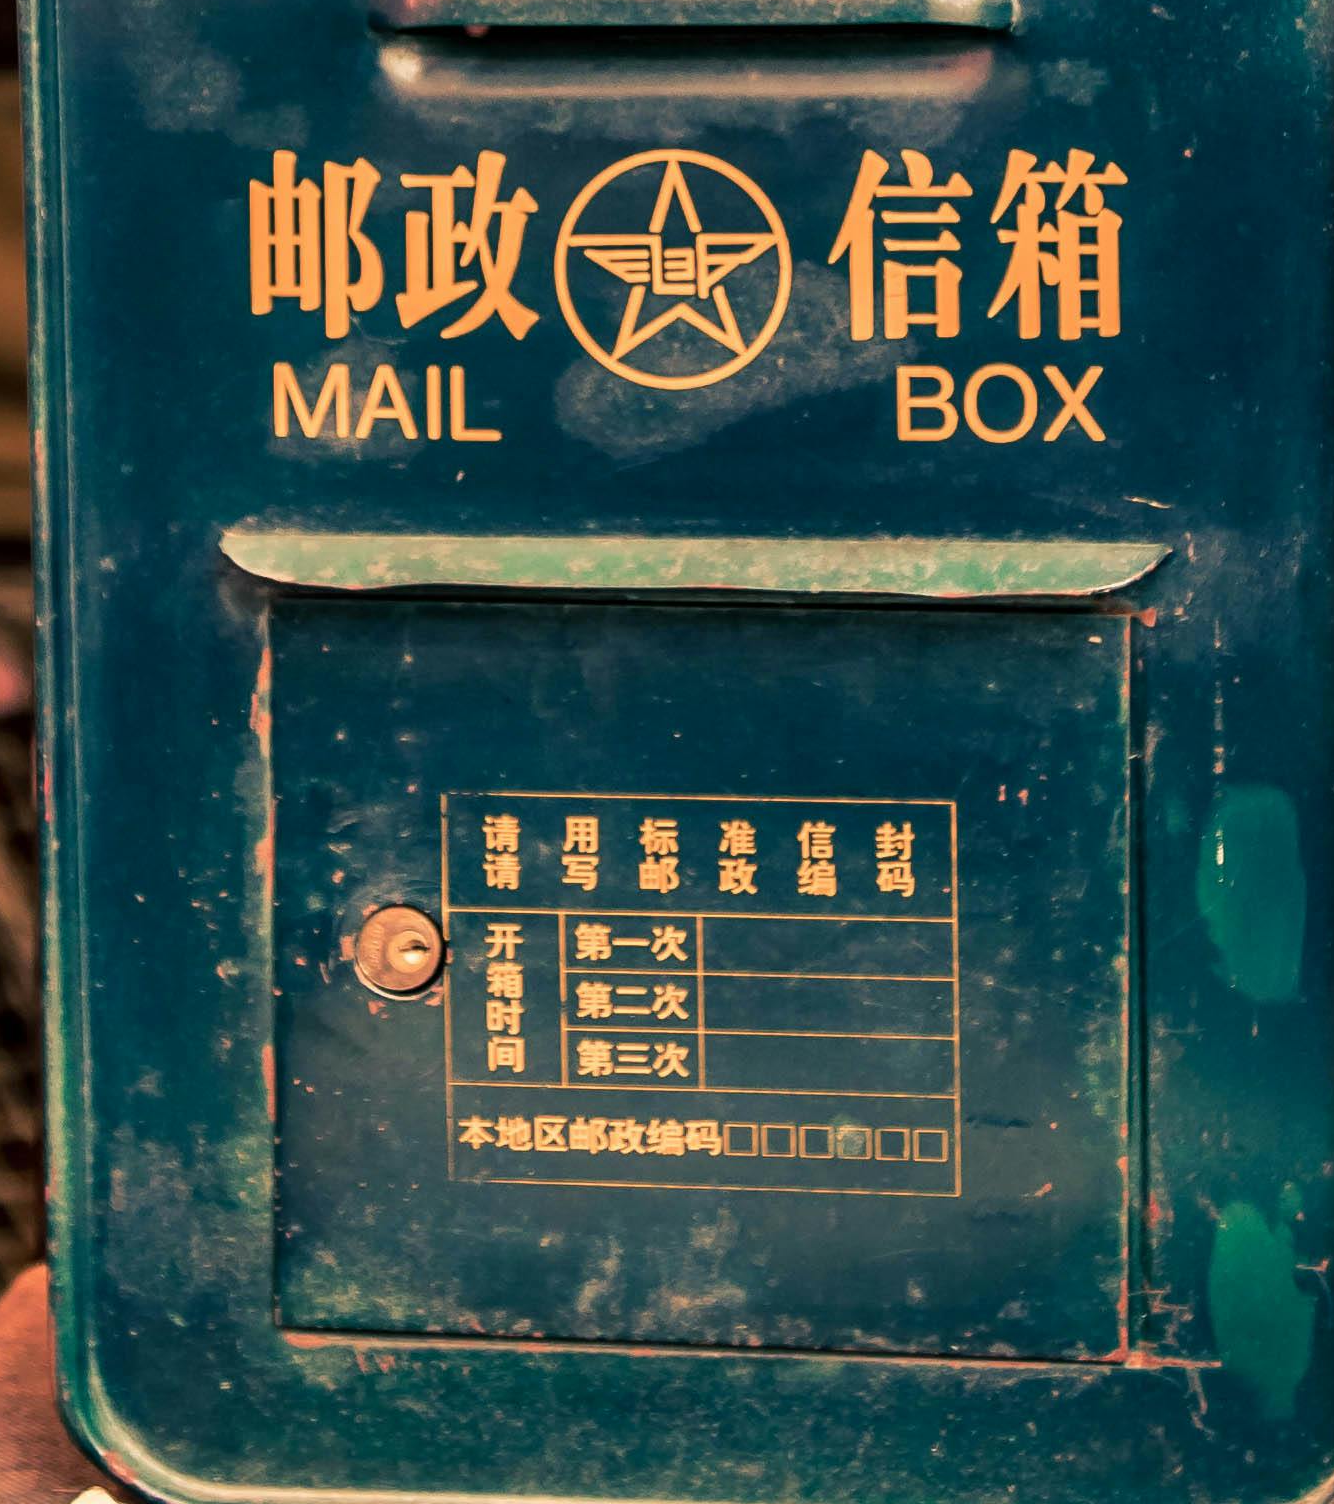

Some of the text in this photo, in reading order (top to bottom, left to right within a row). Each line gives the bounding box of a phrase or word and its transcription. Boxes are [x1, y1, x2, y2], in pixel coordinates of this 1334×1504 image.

[249, 147, 1128, 341] 邮政 信箱
[272, 362, 1105, 444] MAIL BOX
[482, 814, 916, 862] 请用标准信封
[482, 853, 916, 897] 请写邮政编码
[573, 923, 688, 962] 第一次
[484, 923, 525, 1073] 开箱时间
[575, 982, 690, 1020] 第二次
[575, 1040, 691, 1078] 第三次
[457, 1116, 723, 1157] 本地区邮政编码
